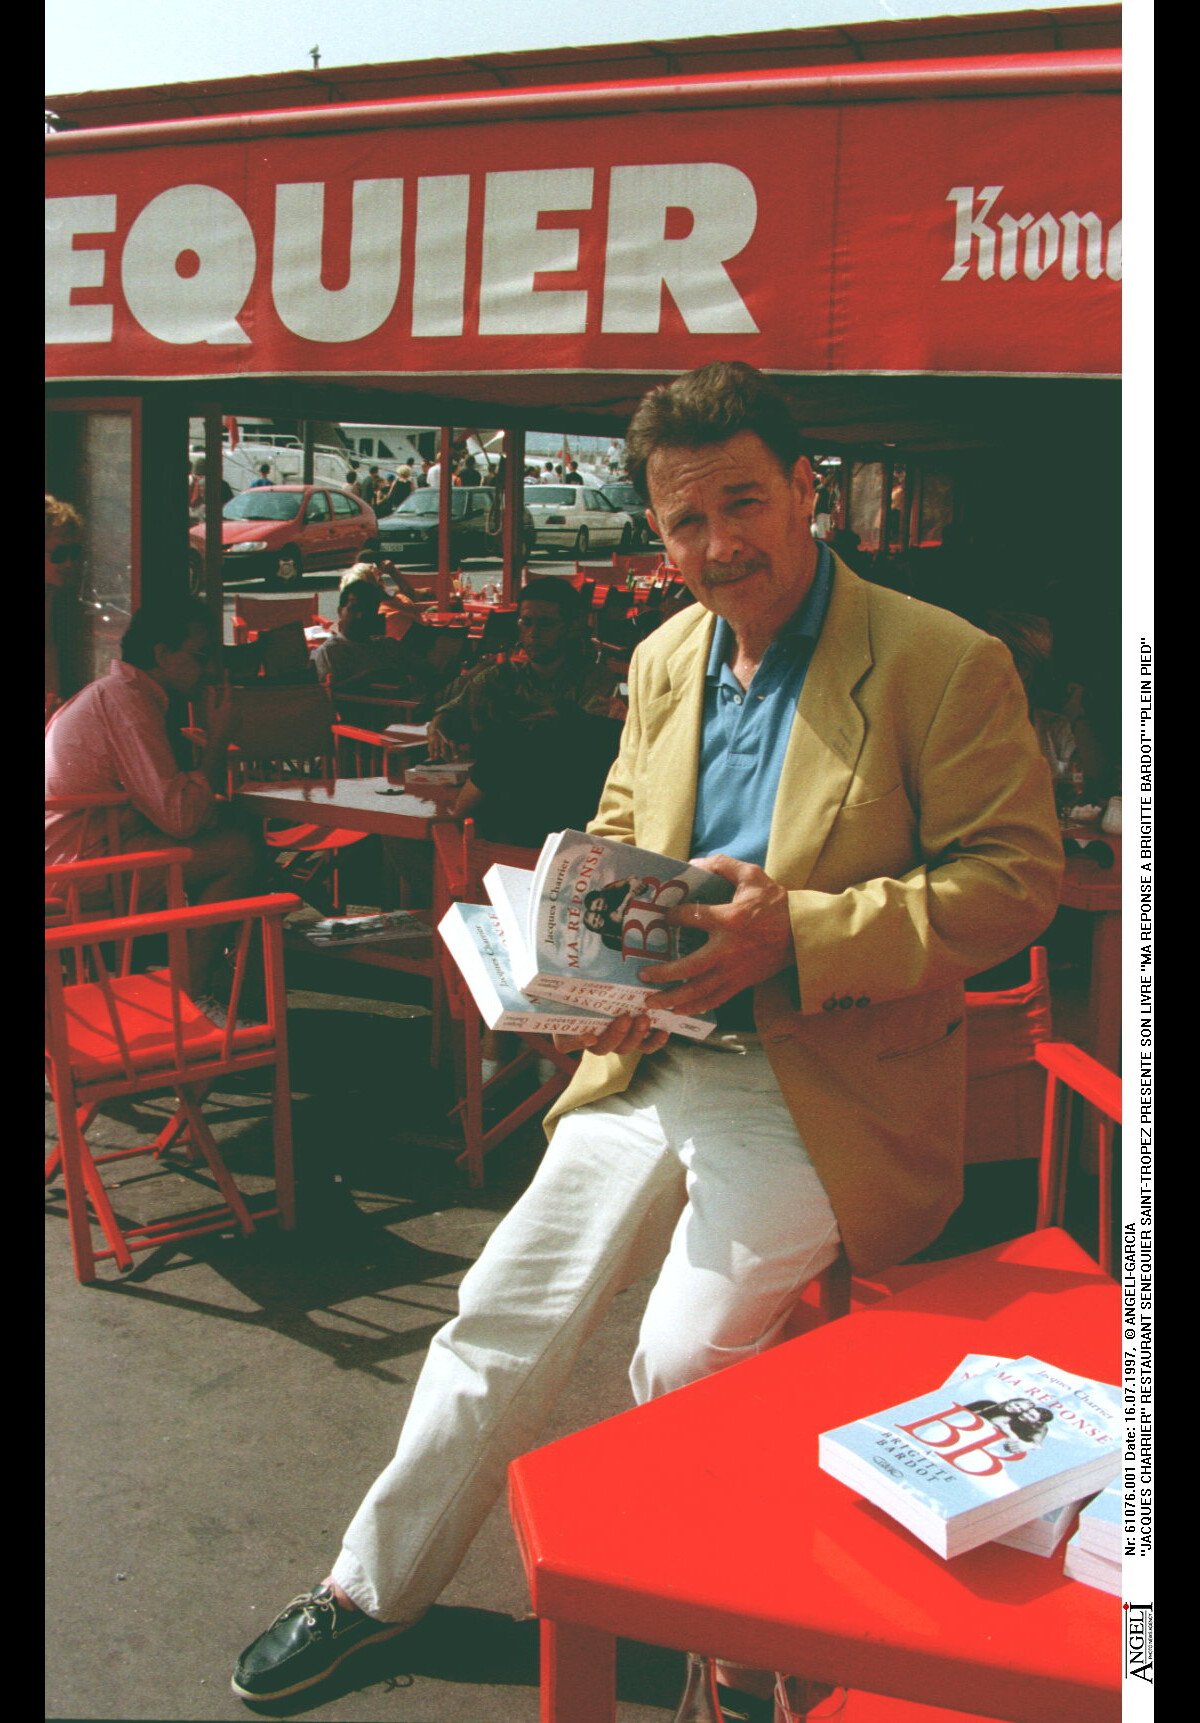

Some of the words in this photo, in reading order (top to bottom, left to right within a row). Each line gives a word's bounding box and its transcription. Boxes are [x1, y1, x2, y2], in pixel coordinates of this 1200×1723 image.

[45, 162, 760, 345] EQUIER
[550, 859, 570, 902] Charrier
[545, 904, 557, 945] Jacques
[621, 876, 690, 962] BB
[567, 942, 580, 969] MA
[994, 1371, 1022, 1387] MA
[1037, 1369, 1072, 1392] Jacques
[1073, 1388, 1115, 1420] Charrier
[875, 1438, 939, 1482] BARDOT
[880, 1431, 957, 1483] BRIGITTE
[894, 1400, 1027, 1477] BB
